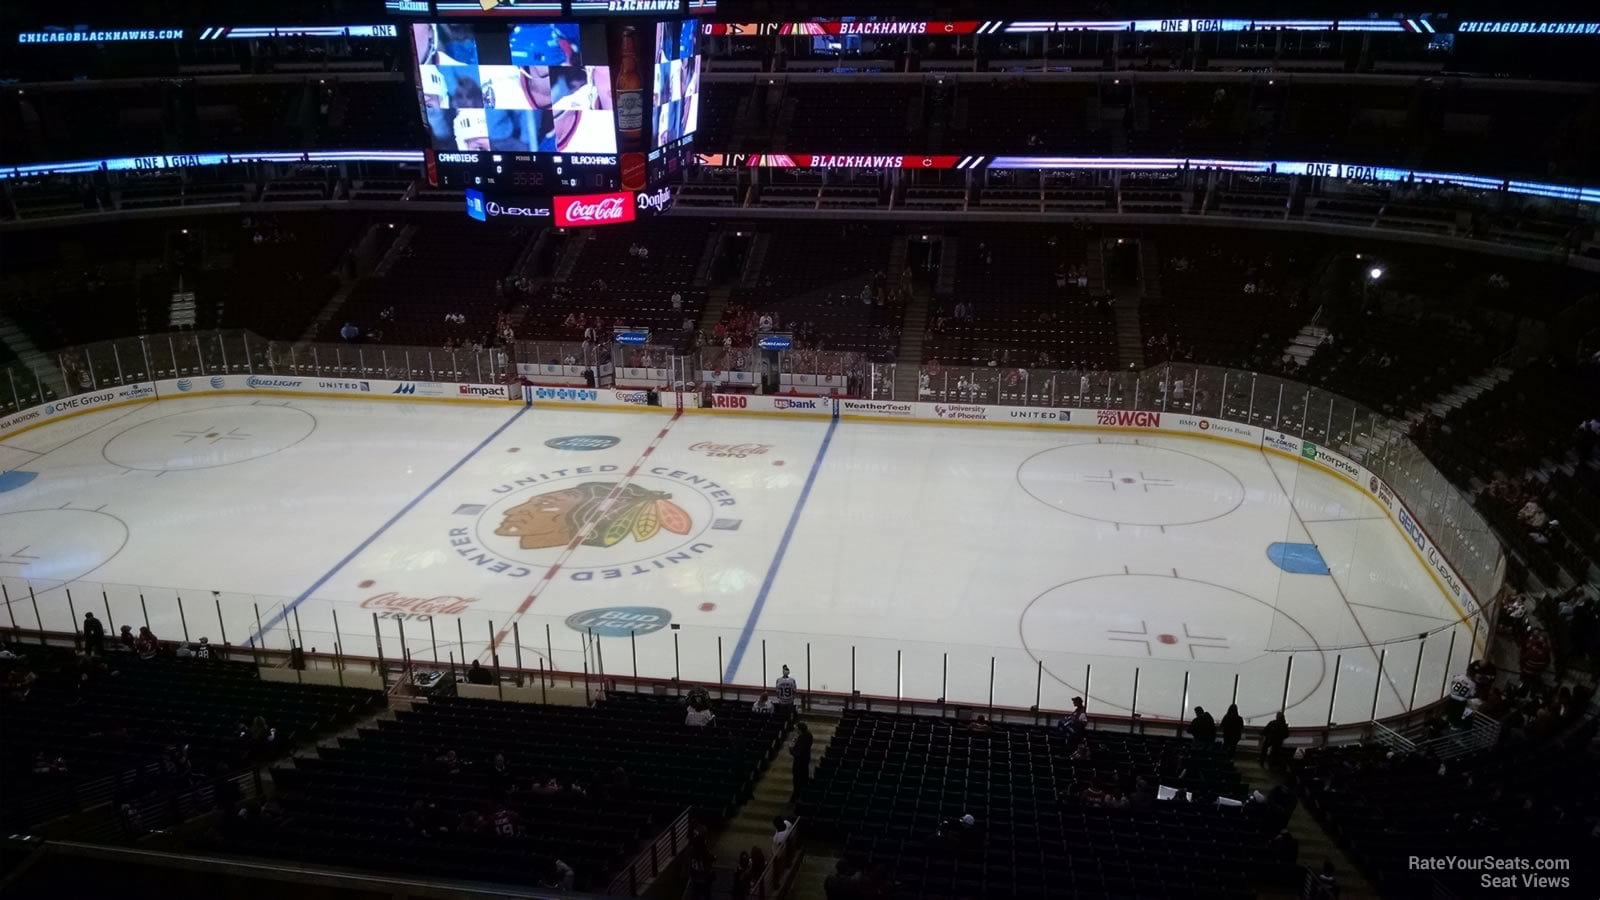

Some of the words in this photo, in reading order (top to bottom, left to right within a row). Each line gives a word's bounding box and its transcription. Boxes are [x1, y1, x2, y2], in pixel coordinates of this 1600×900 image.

[608, 0, 680, 11] BLACKHAWKS
[372, 25, 393, 37] ONE
[839, 22, 926, 35] BLACKHAWKS
[1161, 20, 1183, 32] ONE
[1196, 20, 1224, 32] GOAL
[1459, 22, 1600, 34] CHICAGOBLACKHAW
[18, 29, 184, 43] CHICAGOBLACKHAWKS.COM
[134, 157, 159, 170] ONE
[570, 155, 618, 166] BLACKHAWKS
[810, 156, 903, 169] BLACKHAWKS
[1306, 163, 1332, 177] ONE
[500, 207, 550, 217] LEXUS
[251, 377, 272, 387] BUD
[272, 379, 302, 388] LIGHT
[318, 381, 358, 390] UNITED
[467, 383, 505, 396] impact
[56, 398, 80, 412] CME
[80, 392, 115, 406] Group
[711, 393, 747, 409] ARIBO
[845, 401, 912, 411] WeatherTech
[948, 404, 986, 413] University
[957, 412, 986, 420] Phoenix
[1010, 411, 1057, 419] UNITED
[1097, 415, 1116, 425] 720
[1117, 411, 1161, 428] WGN
[1179, 418, 1197, 427] BMO
[1234, 427, 1252, 436] Bank
[492, 465, 619, 494] UNITED
[651, 467, 736, 508] CENTER
[1398, 508, 1426, 552] GEICO
[449, 527, 532, 578] CENTER
[571, 542, 714, 582] UNITED
[1436, 558, 1461, 597] LEXUS
[378, 611, 432, 622] zero
[599, 611, 660, 622] BUD
[580, 618, 662, 630] LIGHT
[779, 687, 792, 698] 19
[1452, 681, 1470, 697] 88
